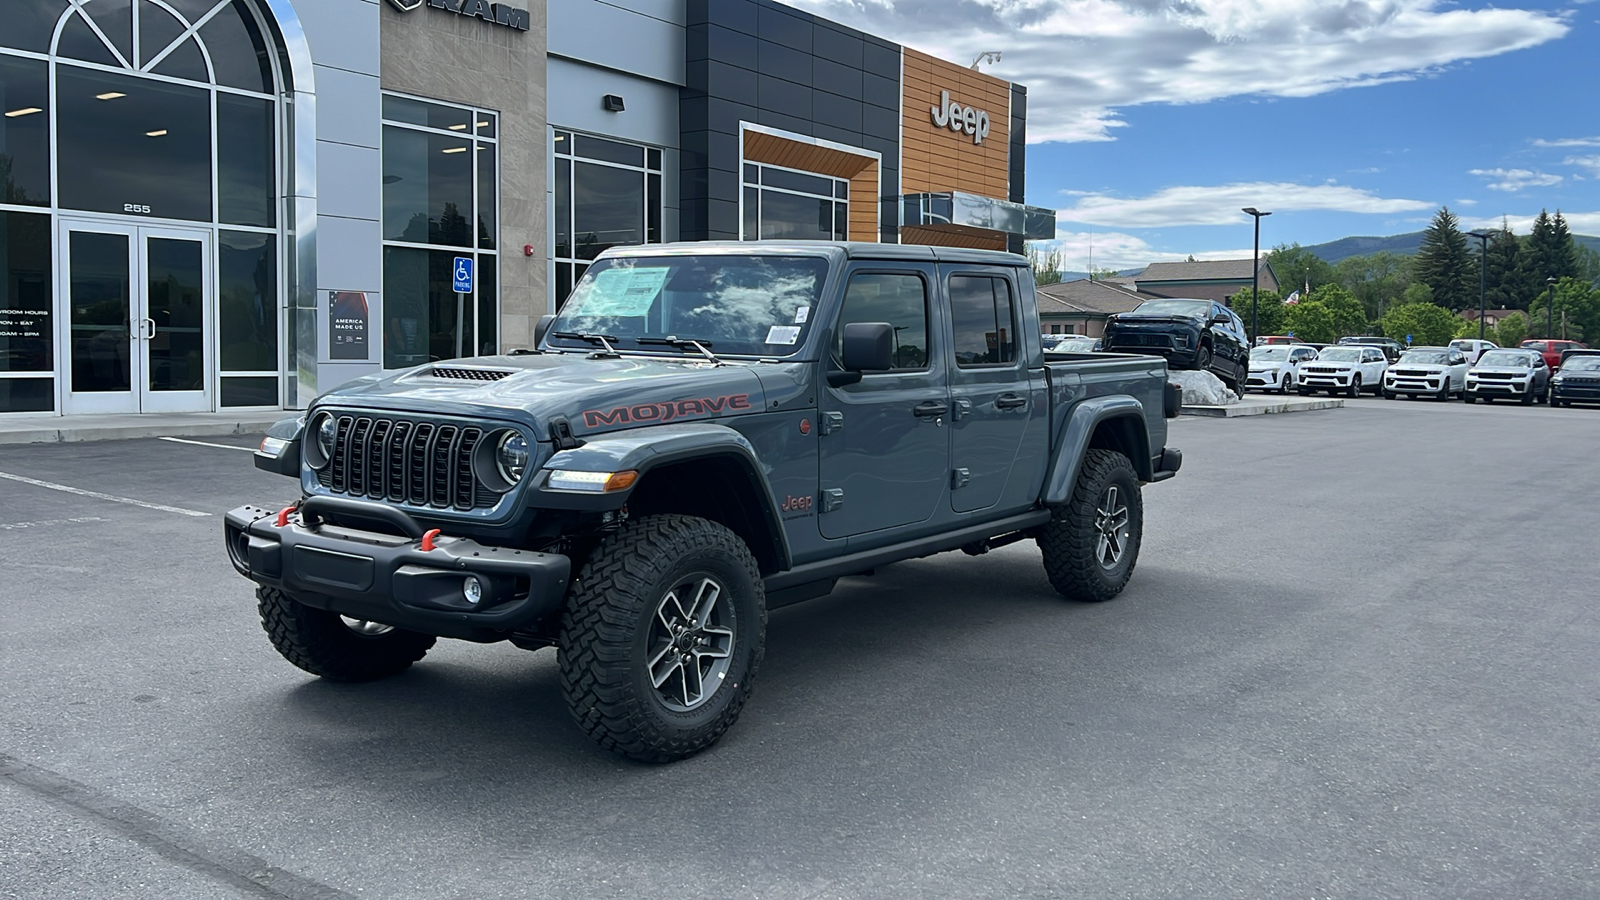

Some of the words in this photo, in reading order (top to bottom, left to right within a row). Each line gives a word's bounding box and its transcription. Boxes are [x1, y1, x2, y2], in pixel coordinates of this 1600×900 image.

[930, 89, 990, 145] Jeep
[123, 203, 151, 213] 255
[582, 394, 751, 429] MOJAVE
[781, 495, 812, 512] Jeep
